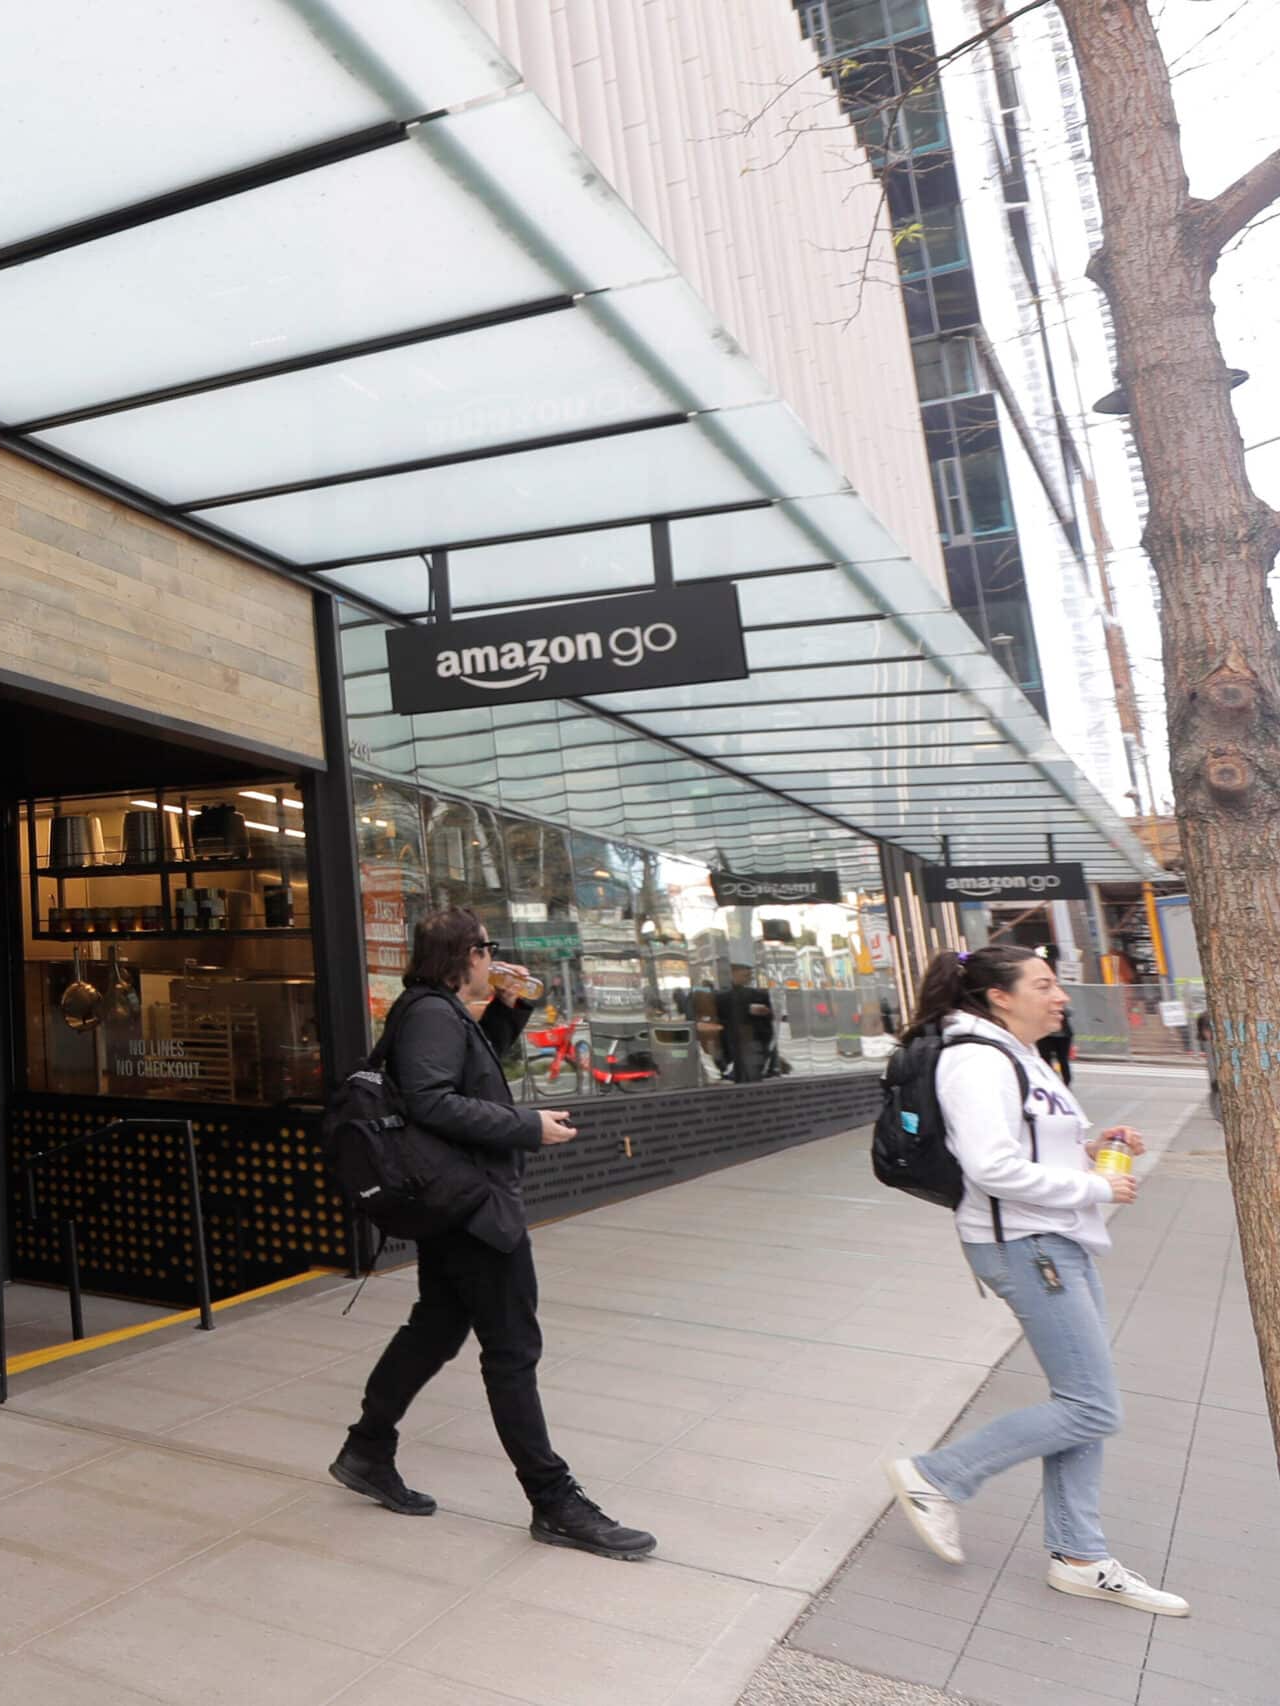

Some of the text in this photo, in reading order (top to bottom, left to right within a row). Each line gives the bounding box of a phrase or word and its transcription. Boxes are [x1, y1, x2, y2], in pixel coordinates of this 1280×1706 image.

[436, 622, 677, 680] amazon go
[944, 874, 1062, 892] amazon go
[128, 1039, 185, 1057] NO LINES
[115, 1060, 200, 1079] NO CHECKOUT
